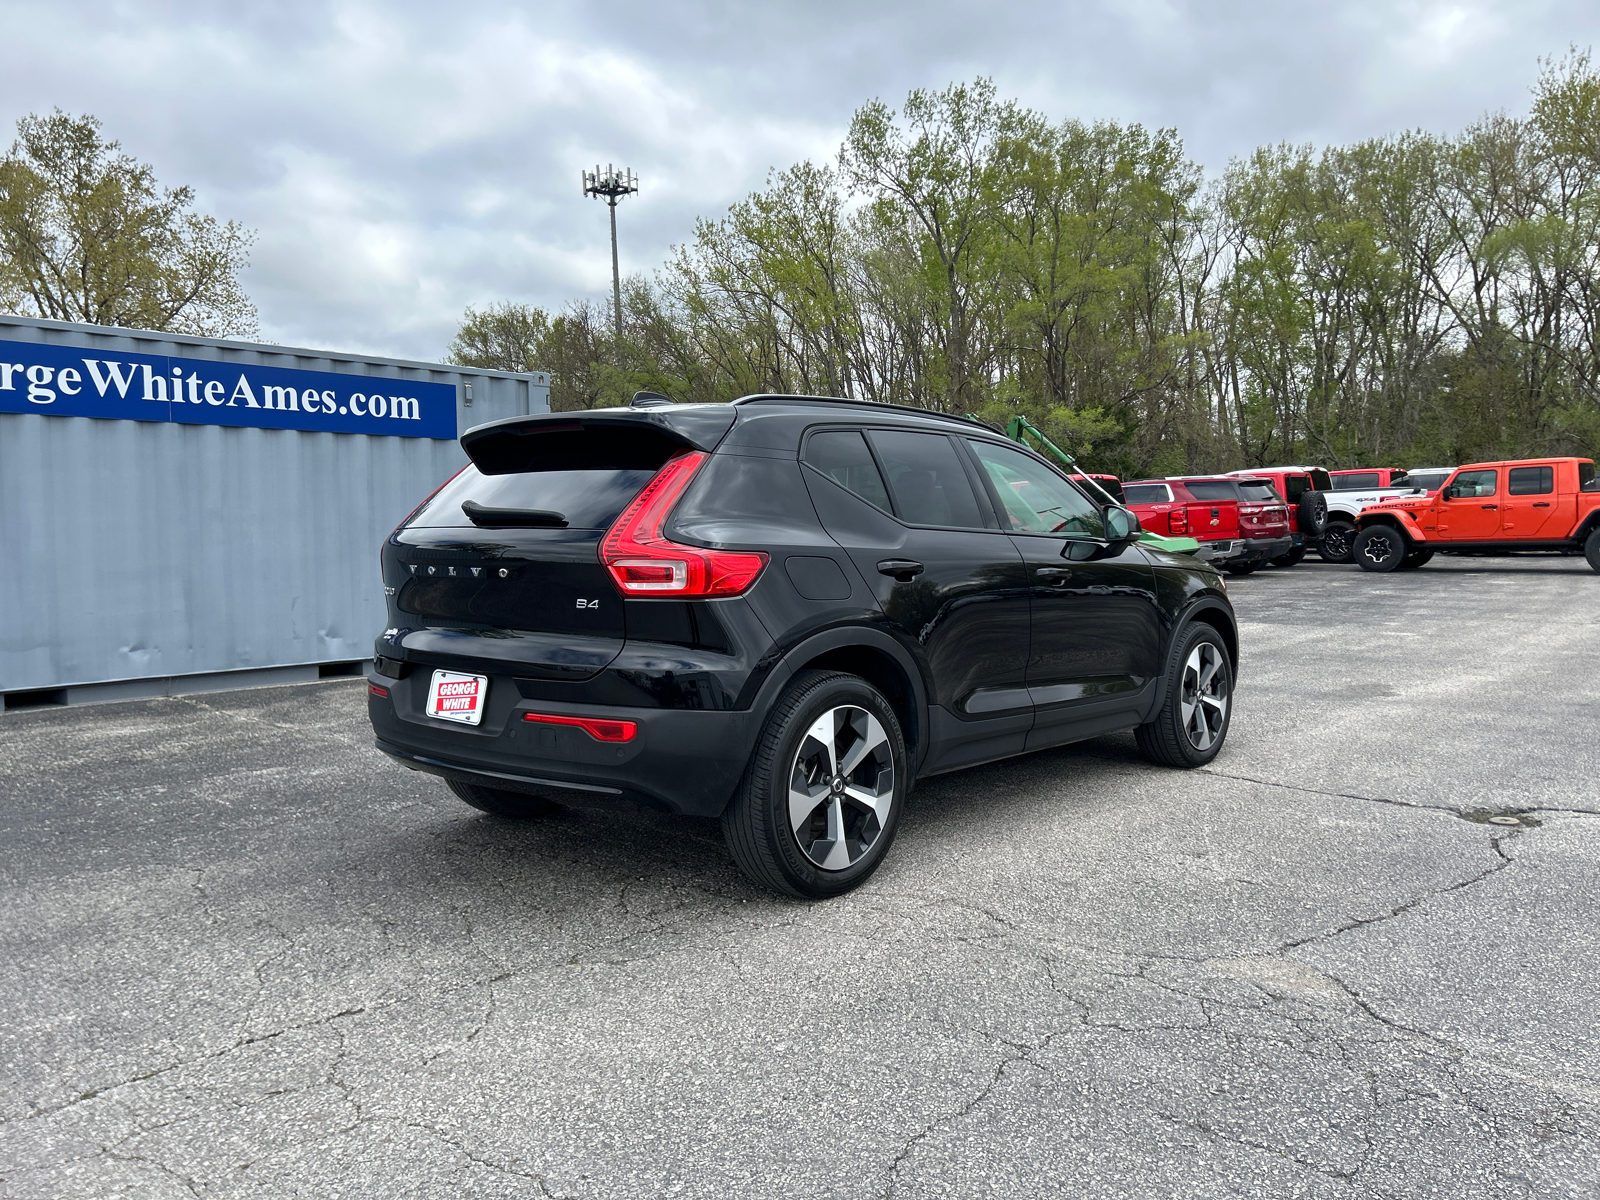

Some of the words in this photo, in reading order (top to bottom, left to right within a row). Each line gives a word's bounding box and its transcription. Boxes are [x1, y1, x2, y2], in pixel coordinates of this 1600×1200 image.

[1370, 502, 1415, 510] RUBICON
[409, 564, 509, 578] VOLVO
[576, 598, 599, 609] B4
[440, 682, 477, 696] GEORGE
[442, 697, 471, 710] WHITE
